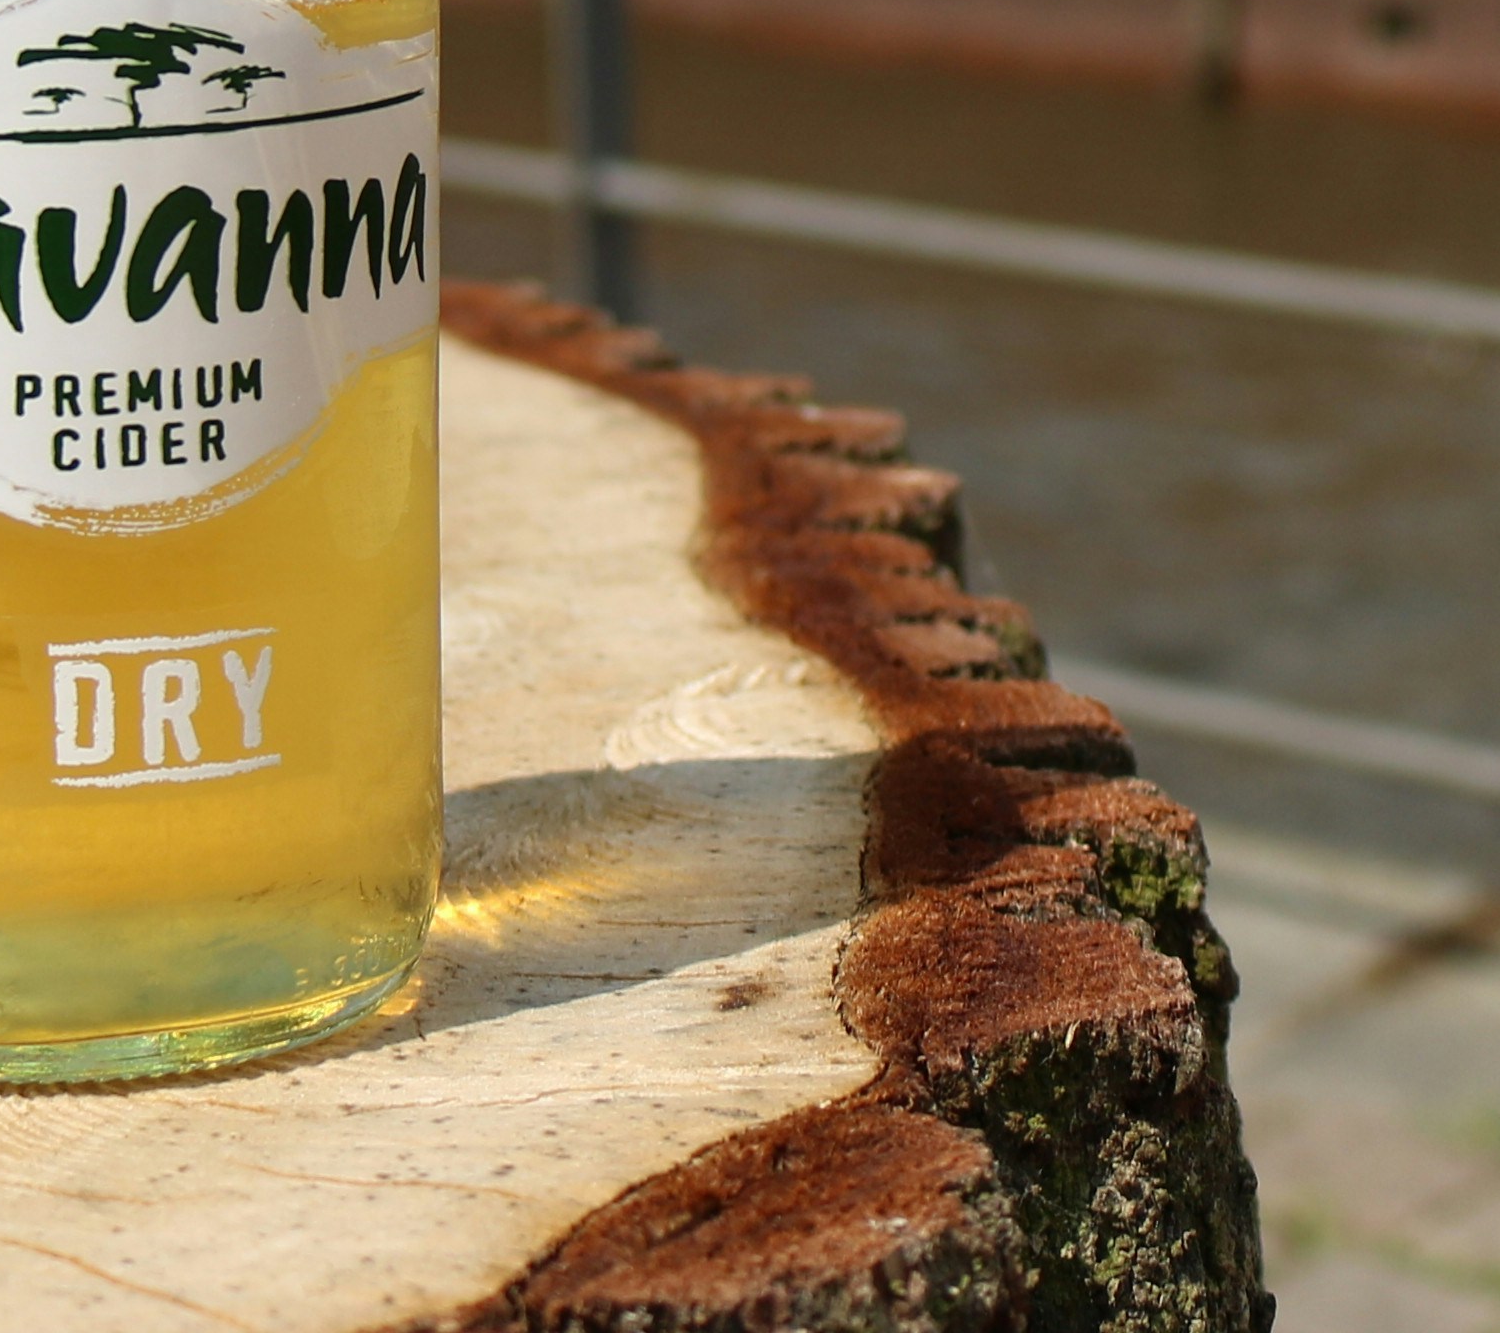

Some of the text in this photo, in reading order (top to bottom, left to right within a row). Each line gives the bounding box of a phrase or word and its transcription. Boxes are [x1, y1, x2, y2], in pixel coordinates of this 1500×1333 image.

[14, 358, 264, 417] PREMIUM
[52, 418, 227, 472] CIDER
[53, 645, 273, 767] DRY
